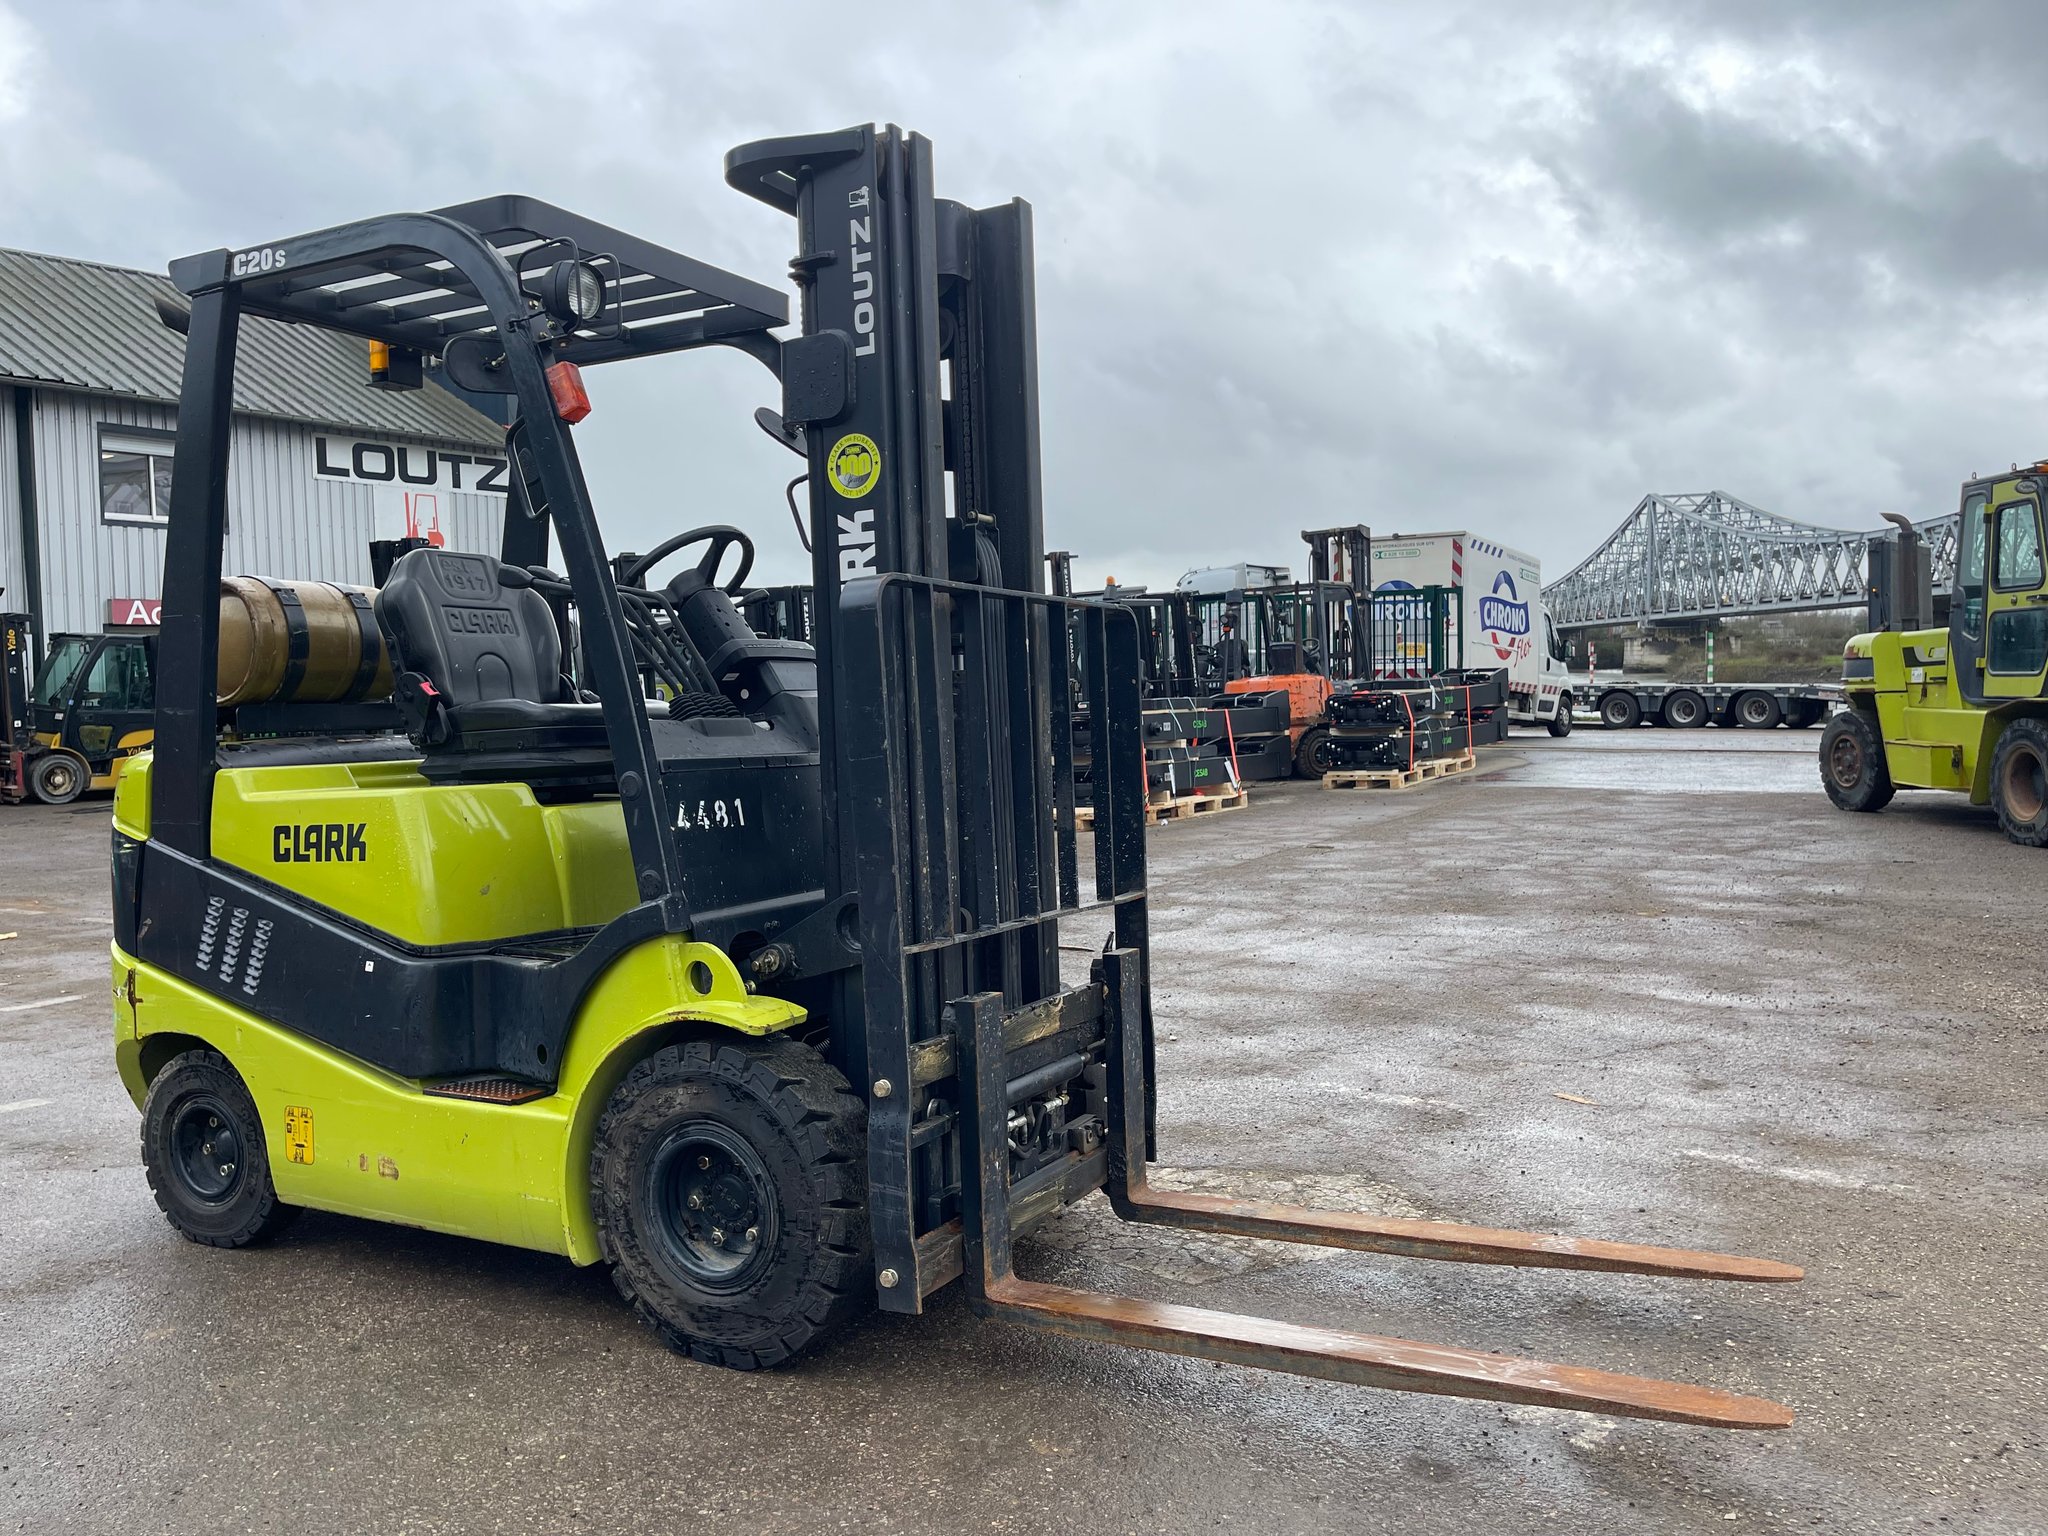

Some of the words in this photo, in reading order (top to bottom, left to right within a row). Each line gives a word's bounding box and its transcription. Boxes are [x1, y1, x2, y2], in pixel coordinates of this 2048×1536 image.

[850, 215, 876, 357] LOUTZ
[315, 437, 510, 493] LOUTZ
[838, 452, 872, 477] 100
[445, 575, 488, 592] 1917
[450, 611, 516, 634] CLARK
[803, 604, 811, 640] LOUTZ
[1484, 601, 1526, 633] CHRONO
[7, 629, 16, 651] Yale
[1193, 720, 1207, 728] CESAB
[1194, 768, 1208, 777] CESAB
[273, 823, 367, 862] CLARK
